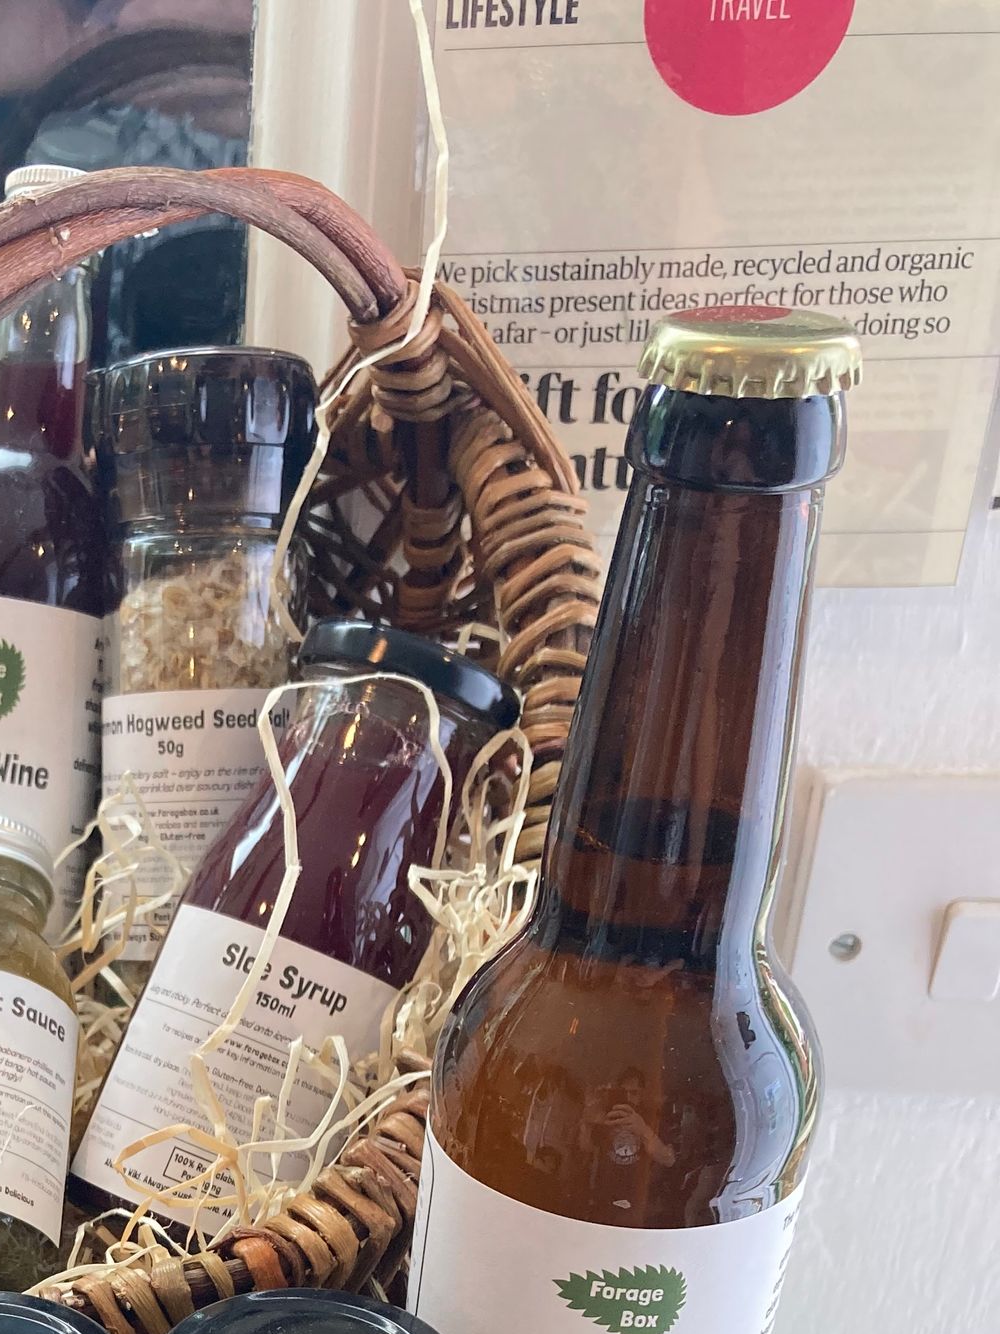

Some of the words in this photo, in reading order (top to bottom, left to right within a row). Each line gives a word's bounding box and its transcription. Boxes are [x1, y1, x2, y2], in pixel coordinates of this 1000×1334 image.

[471, 259, 520, 288] pick
[522, 254, 656, 285] sustainably
[658, 254, 727, 280] made,
[733, 250, 831, 283] recycled
[836, 248, 882, 273] and
[885, 247, 975, 278] organic
[548, 290, 641, 319] present
[640, 287, 700, 312] ideas
[793, 282, 825, 306] for
[828, 281, 894, 305] those
[899, 279, 948, 303] who
[554, 326, 581, 345] or
[580, 321, 627, 348] just
[854, 313, 920, 339] doing
[923, 315, 951, 334] so
[590, 372, 643, 425] fo
[127, 709, 205, 737] Hogweed
[213, 708, 257, 730] Seed
[157, 740, 185, 758] 50g
[255, 991, 297, 1019] 150ml
[279, 965, 348, 1016] Syrup
[11, 996, 66, 1042] Sauce
[588, 1280, 664, 1307] Forage
[619, 1310, 659, 1329] Box
